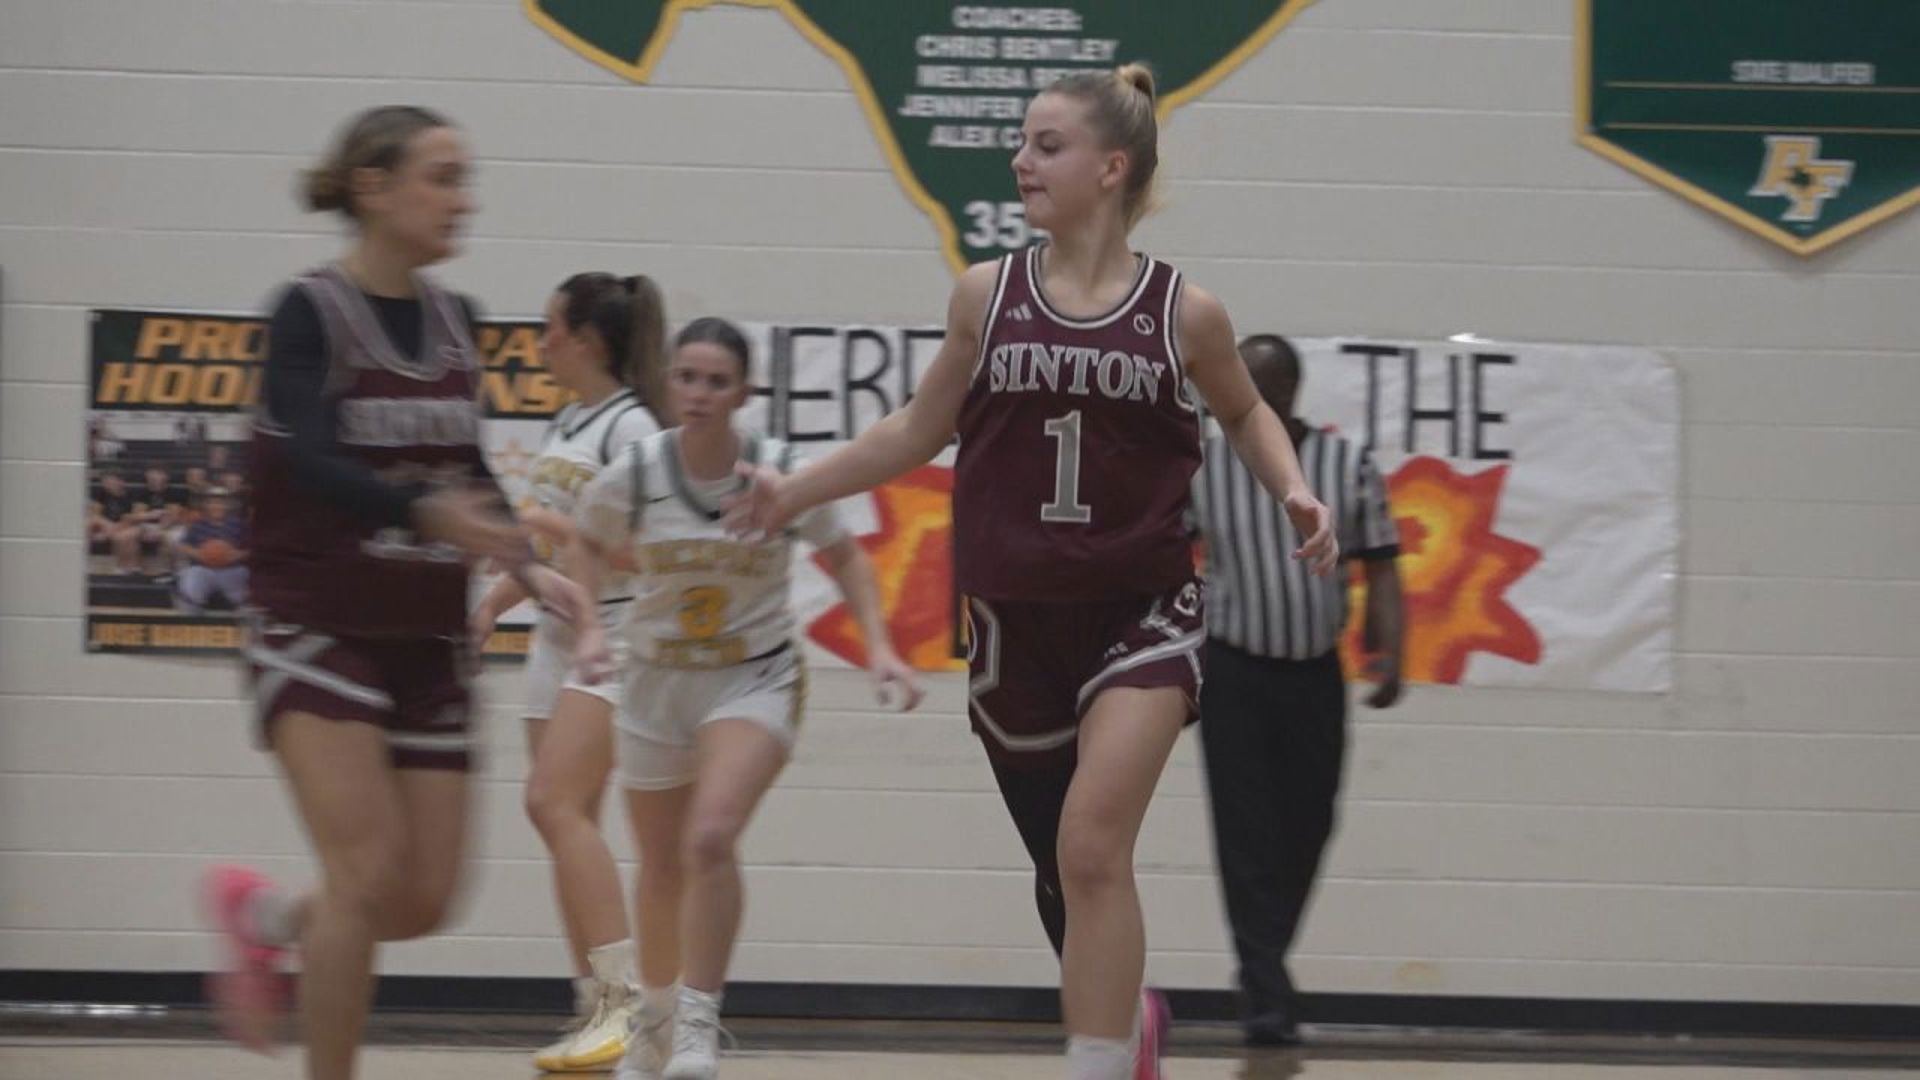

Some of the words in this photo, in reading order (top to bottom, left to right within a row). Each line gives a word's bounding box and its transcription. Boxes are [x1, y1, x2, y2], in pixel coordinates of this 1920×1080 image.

[915, 34, 997, 58] CHRIS
[1001, 37, 1119, 61] BENTLEY
[916, 64, 1027, 88] MELISSA
[898, 94, 1024, 118] JENNIFER
[989, 343, 1166, 405] SINTON
[1340, 344, 1515, 459] THE
[1041, 410, 1091, 523] 1
